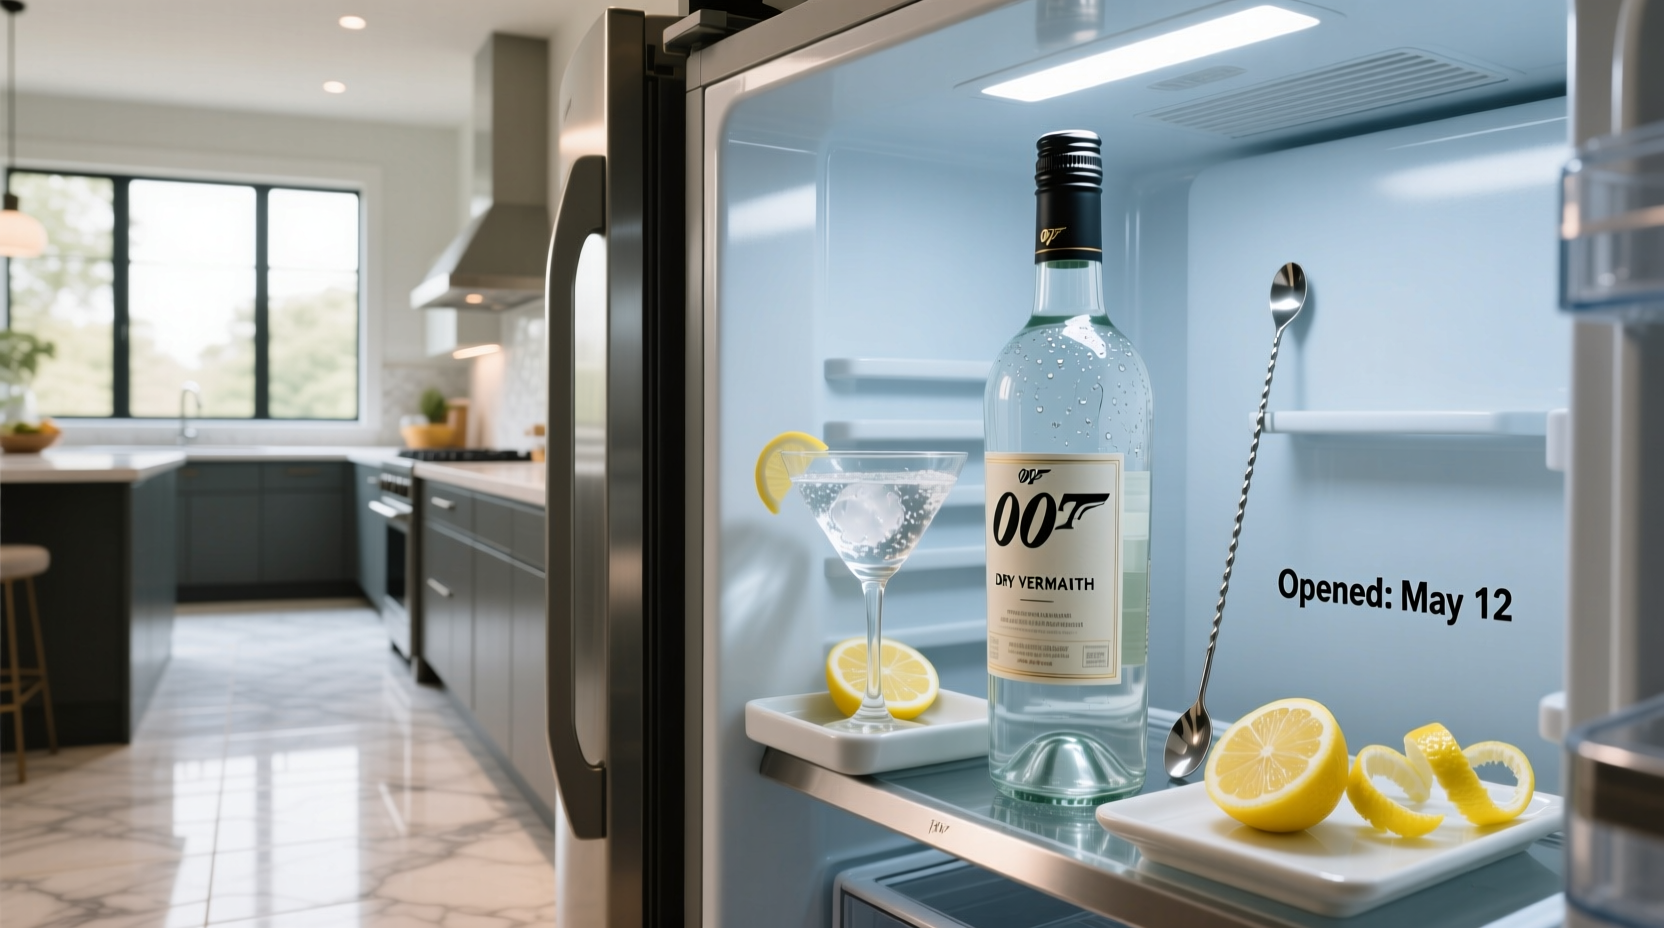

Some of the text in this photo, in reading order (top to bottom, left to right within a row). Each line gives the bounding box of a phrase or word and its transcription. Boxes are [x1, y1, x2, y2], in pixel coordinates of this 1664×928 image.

[993, 491, 1111, 549] 007
[995, 572, 1095, 591] DRY VERMAITH
[1278, 568, 1513, 626] Opened: May 12
